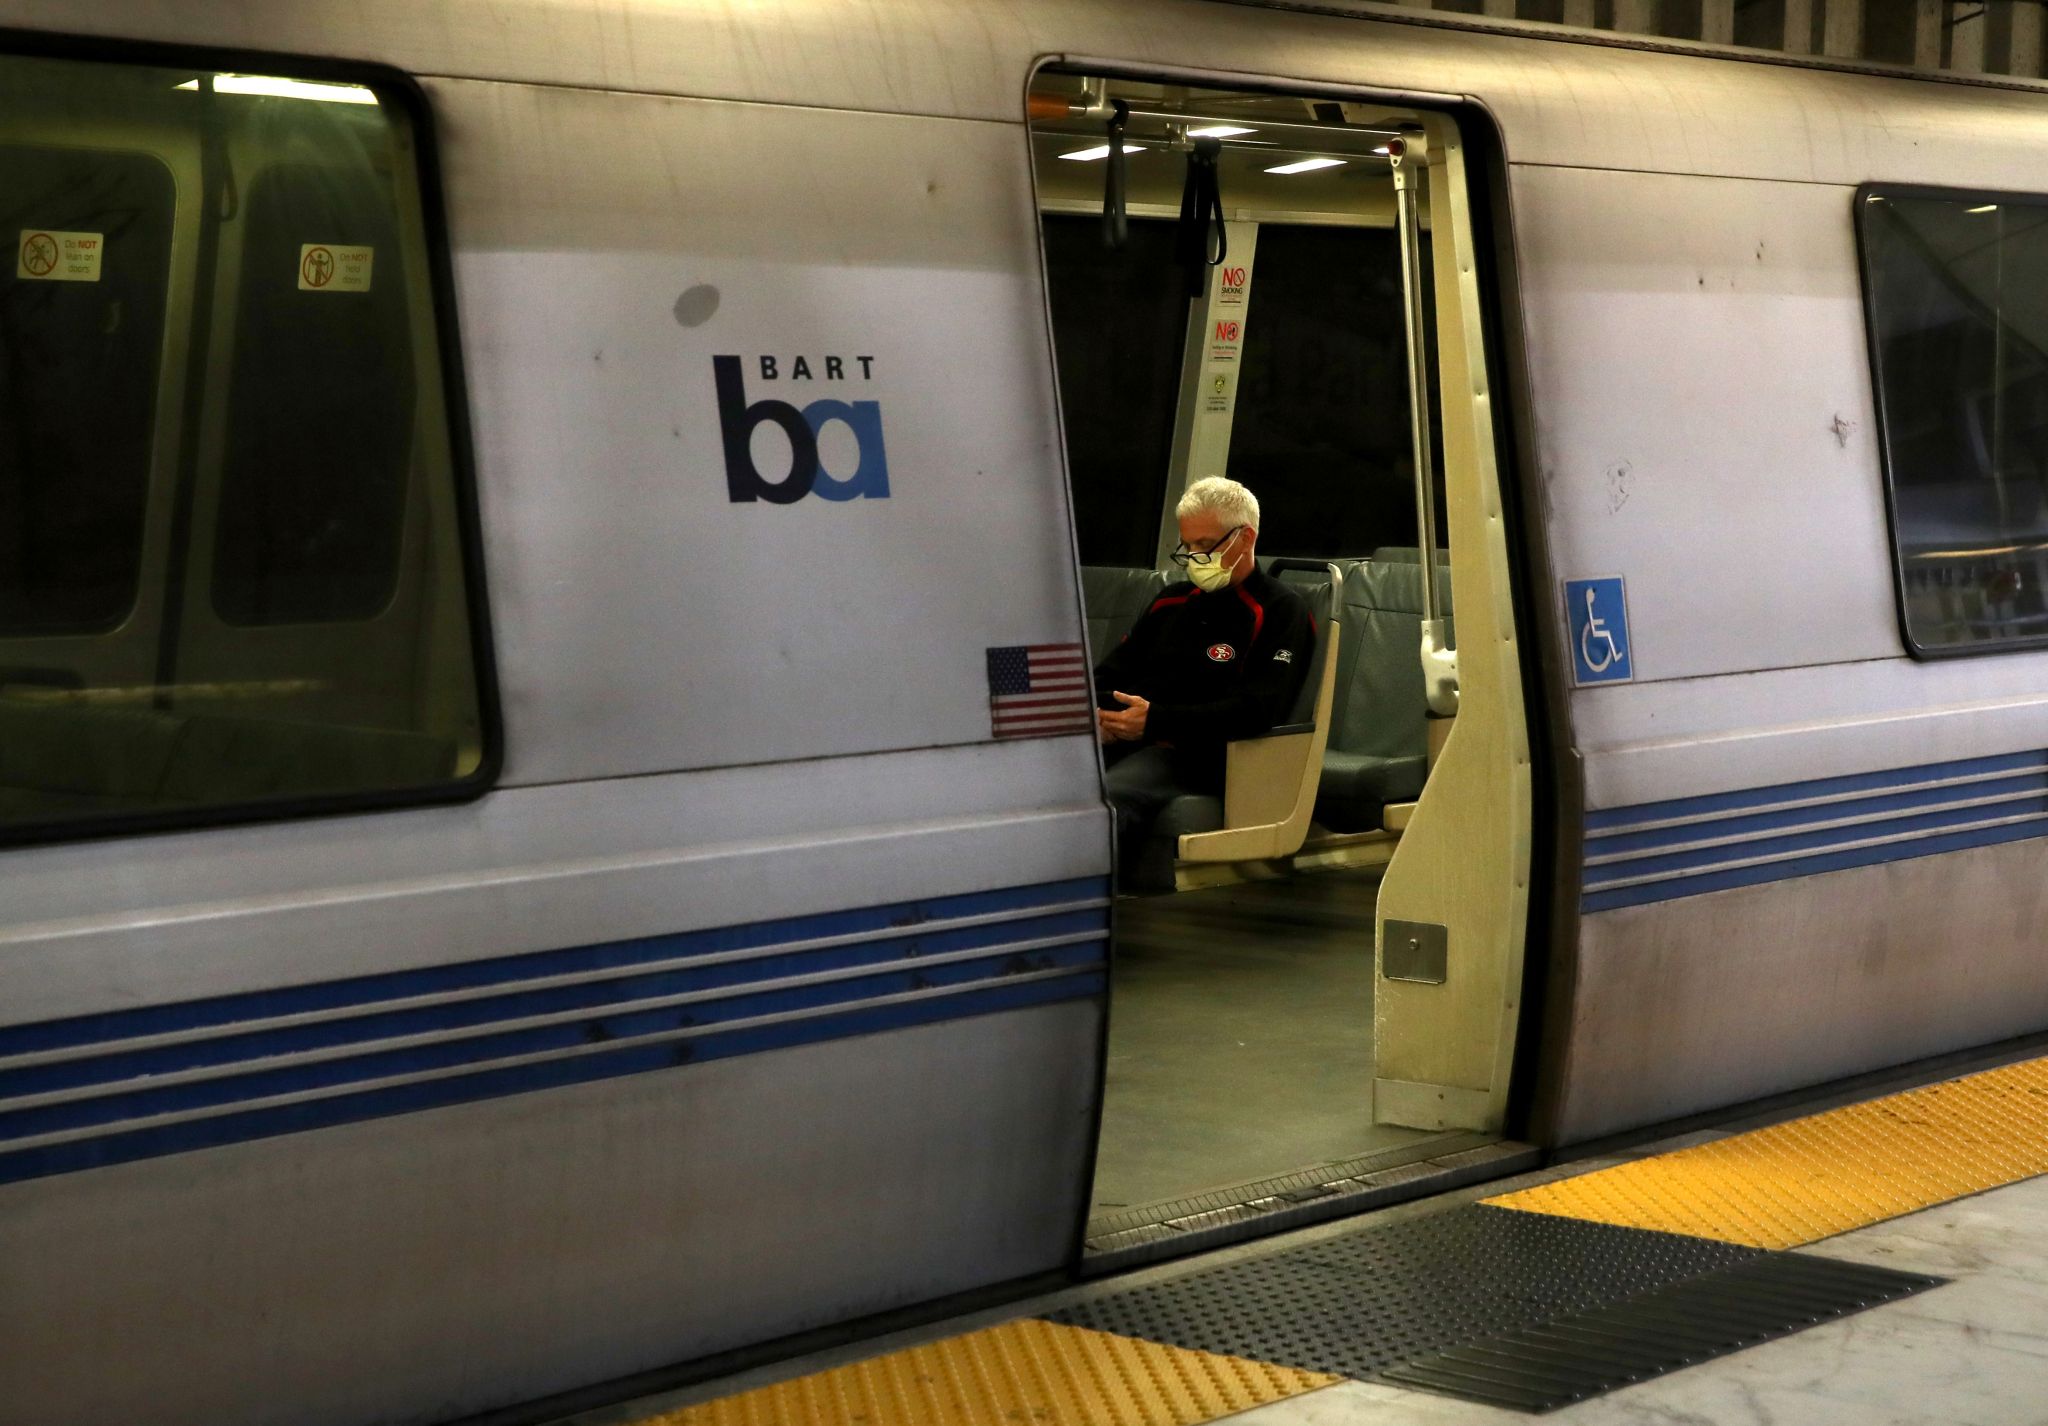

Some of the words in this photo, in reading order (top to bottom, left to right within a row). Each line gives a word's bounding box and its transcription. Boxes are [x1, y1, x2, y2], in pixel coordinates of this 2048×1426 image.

[78, 240, 97, 249] NOT
[1222, 267, 1246, 287] NO
[1215, 321, 1239, 341] NO
[760, 355, 874, 380] BART
[713, 355, 891, 504] ba
